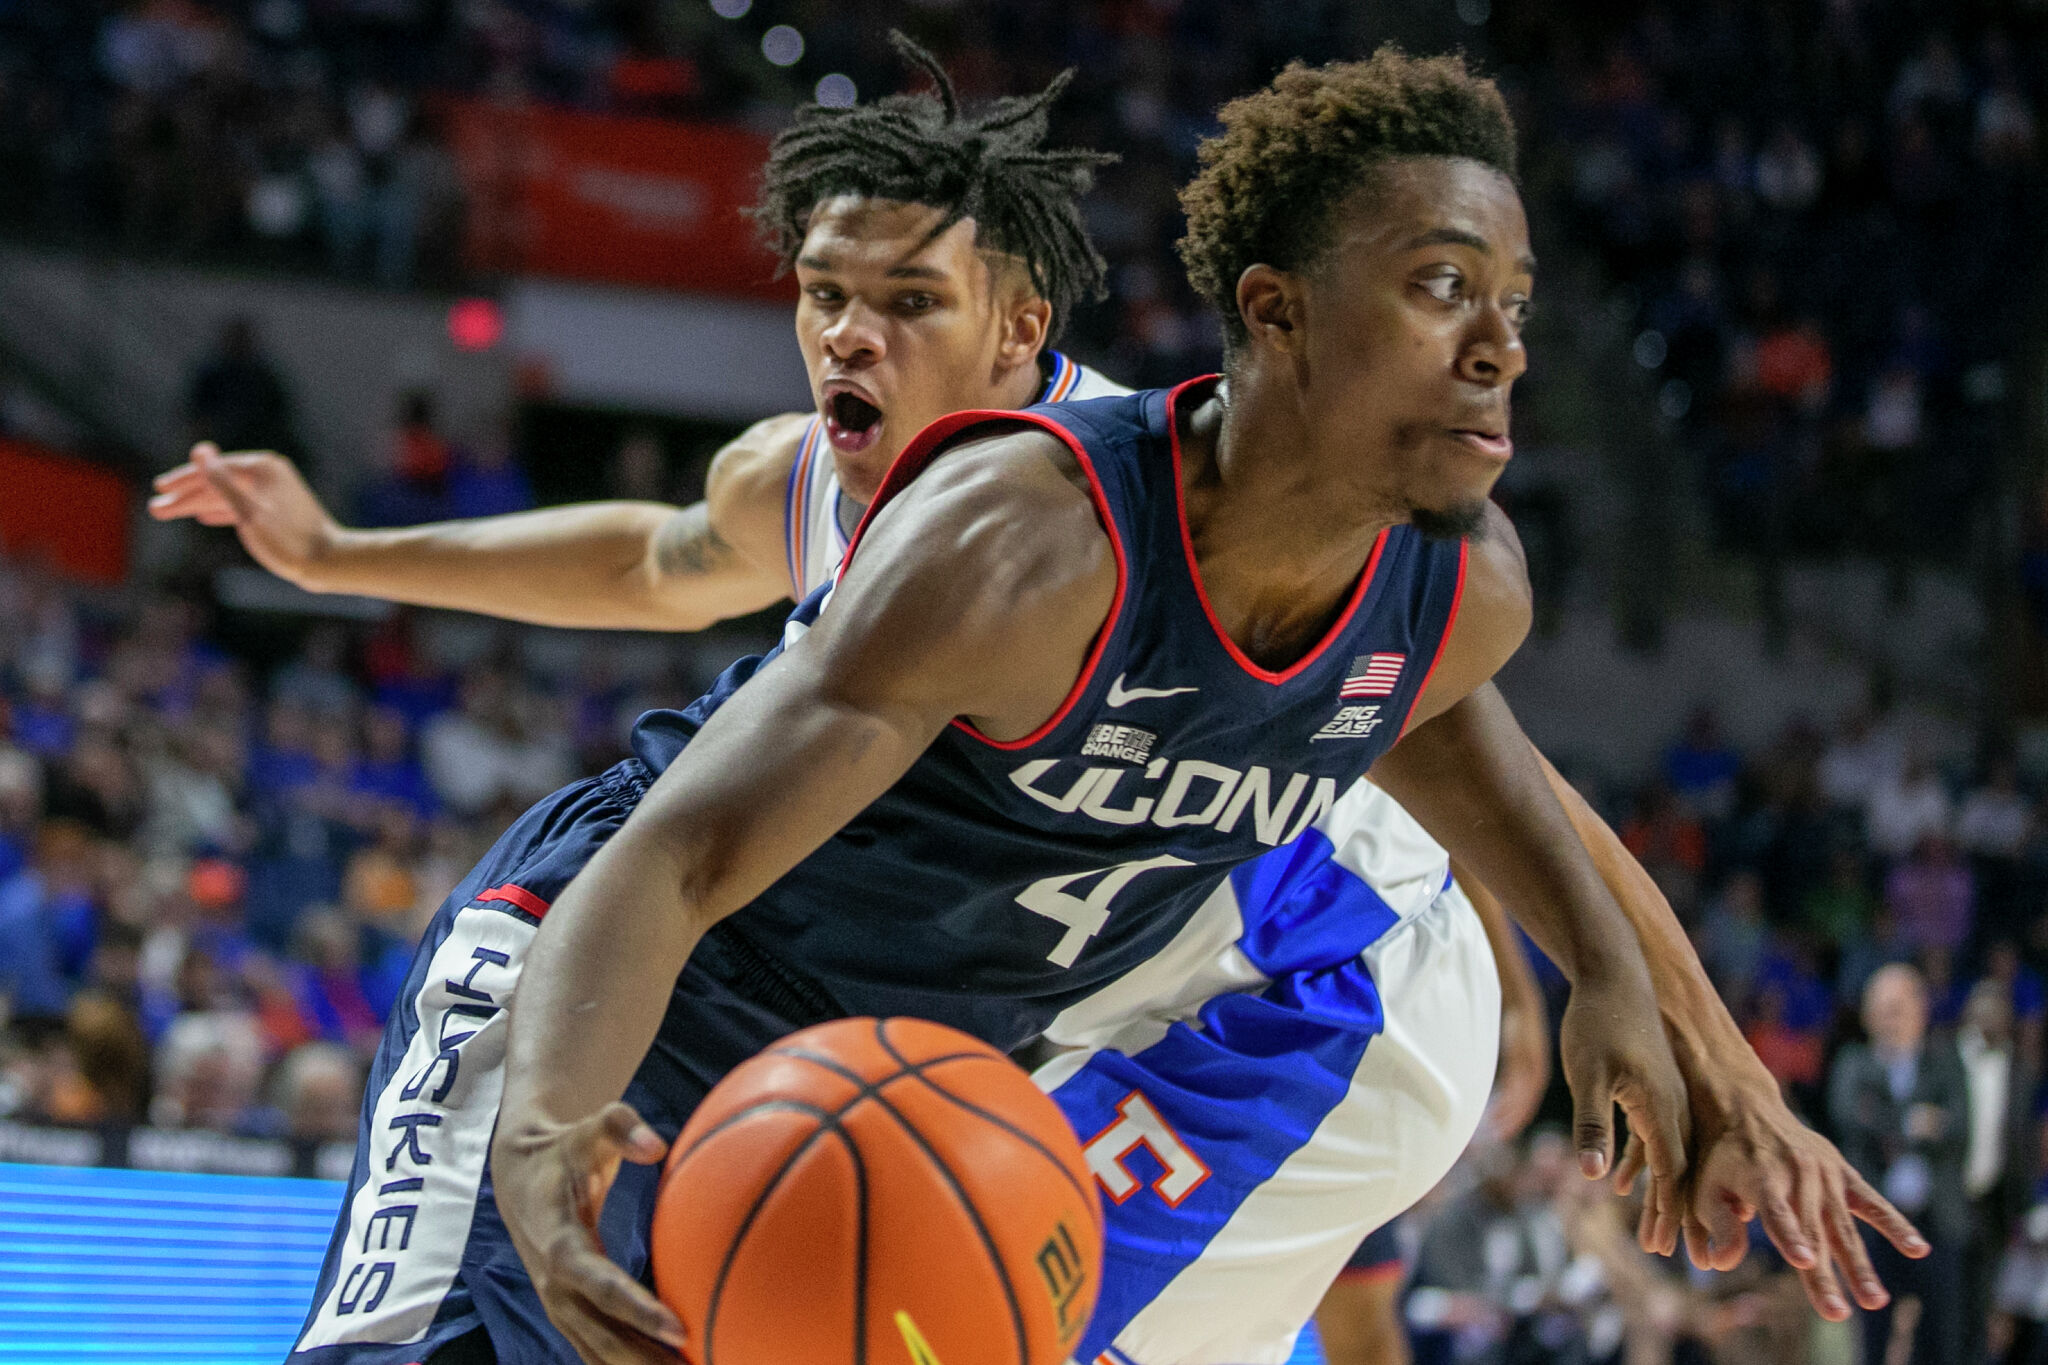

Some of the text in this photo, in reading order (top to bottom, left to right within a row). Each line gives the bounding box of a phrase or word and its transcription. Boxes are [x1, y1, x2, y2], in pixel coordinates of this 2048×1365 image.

[1334, 704, 1382, 721] BIG
[1096, 724, 1132, 745] BE
[1322, 718, 1383, 735] EAST
[1081, 742, 1150, 765] CHANGE
[1014, 853, 1199, 969] 4
[336, 946, 511, 1317] HUSKIES
